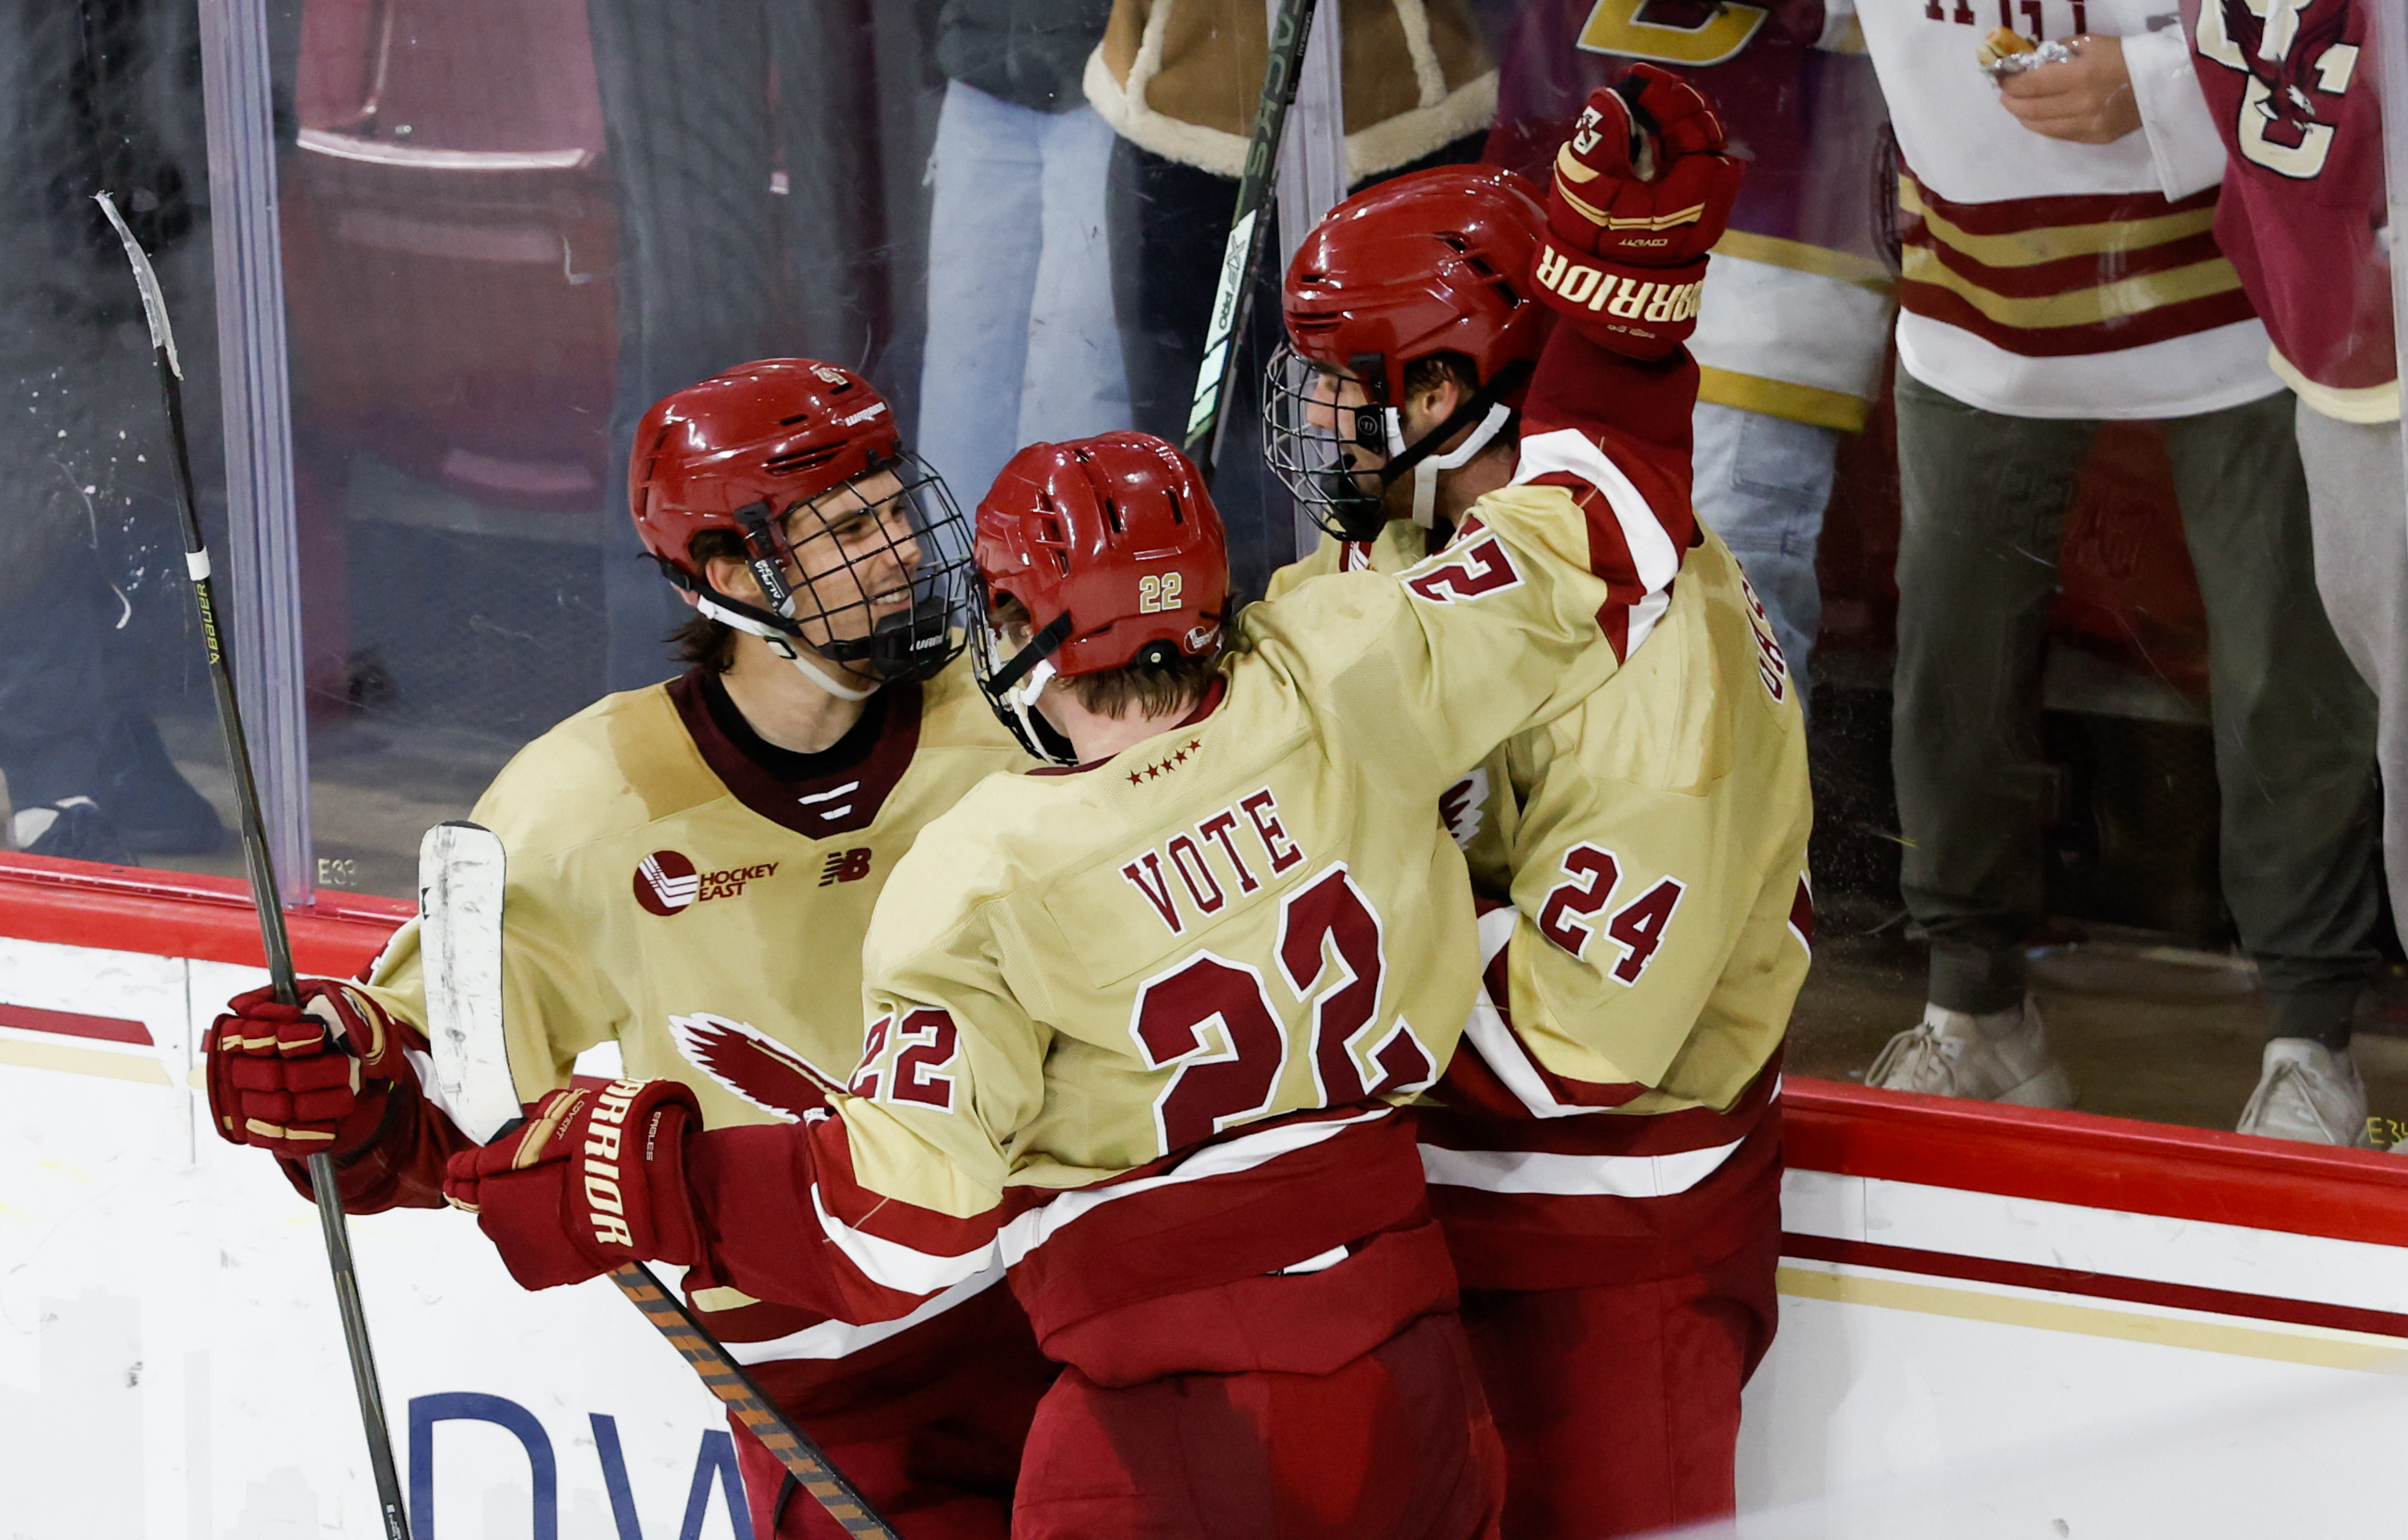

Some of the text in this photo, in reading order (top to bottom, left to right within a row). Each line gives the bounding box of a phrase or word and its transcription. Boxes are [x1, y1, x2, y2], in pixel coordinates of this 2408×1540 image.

[1218, 290, 1235, 331] PRO
[755, 561, 782, 599] ALPHA
[1139, 572, 1183, 614] 22
[196, 583, 219, 651] BAUER
[700, 862, 779, 886] HOCKEY
[1117, 784, 1308, 938] VOTE
[698, 882, 746, 902] EAST
[1536, 840, 1689, 988] 24
[1128, 859, 1438, 1158] 22
[846, 1004, 961, 1115] 22
[555, 1099, 586, 1140] COVERT
[645, 1111, 662, 1162] EAGLES
[584, 1077, 654, 1248] ARRIOR
